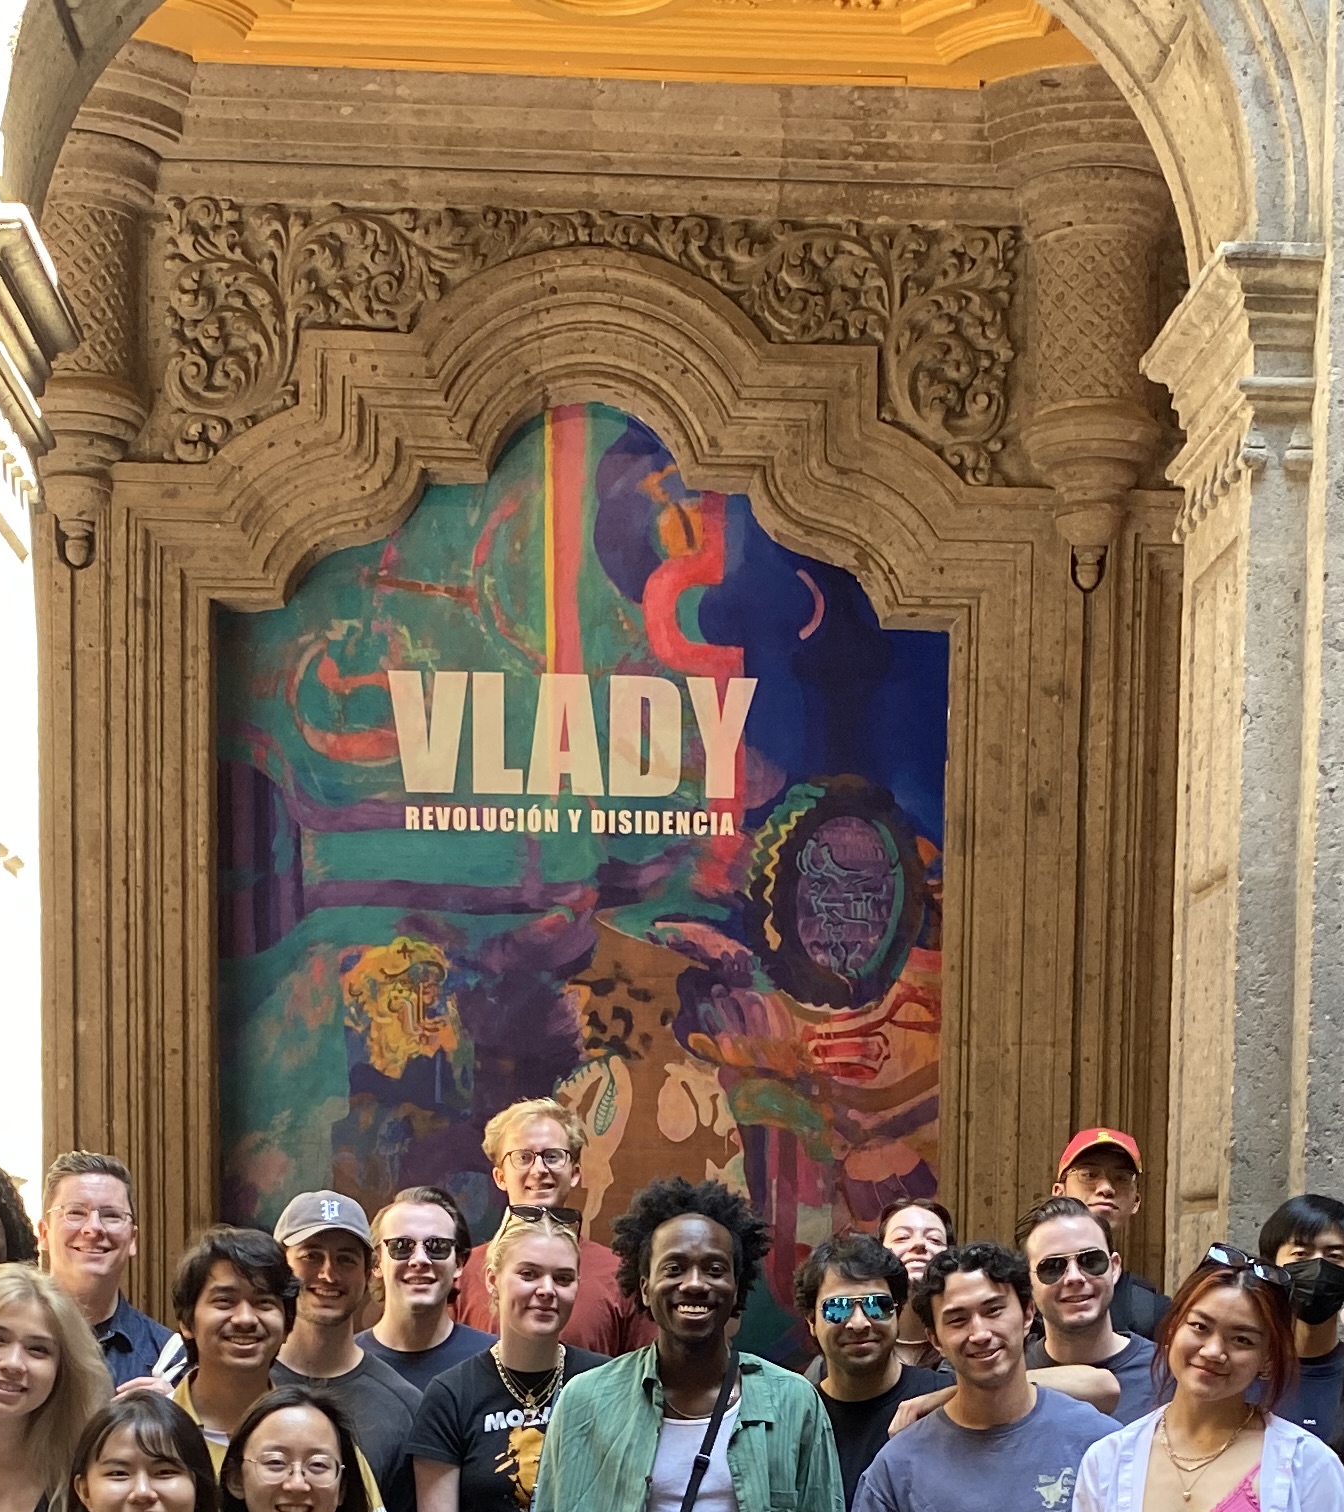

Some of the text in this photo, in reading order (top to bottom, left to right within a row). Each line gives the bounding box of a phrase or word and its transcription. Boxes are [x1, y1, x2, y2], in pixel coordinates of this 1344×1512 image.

[388, 670, 758, 798] VLADY
[406, 804, 736, 836] REVOLUCIÓN Y DISIDENCIA
